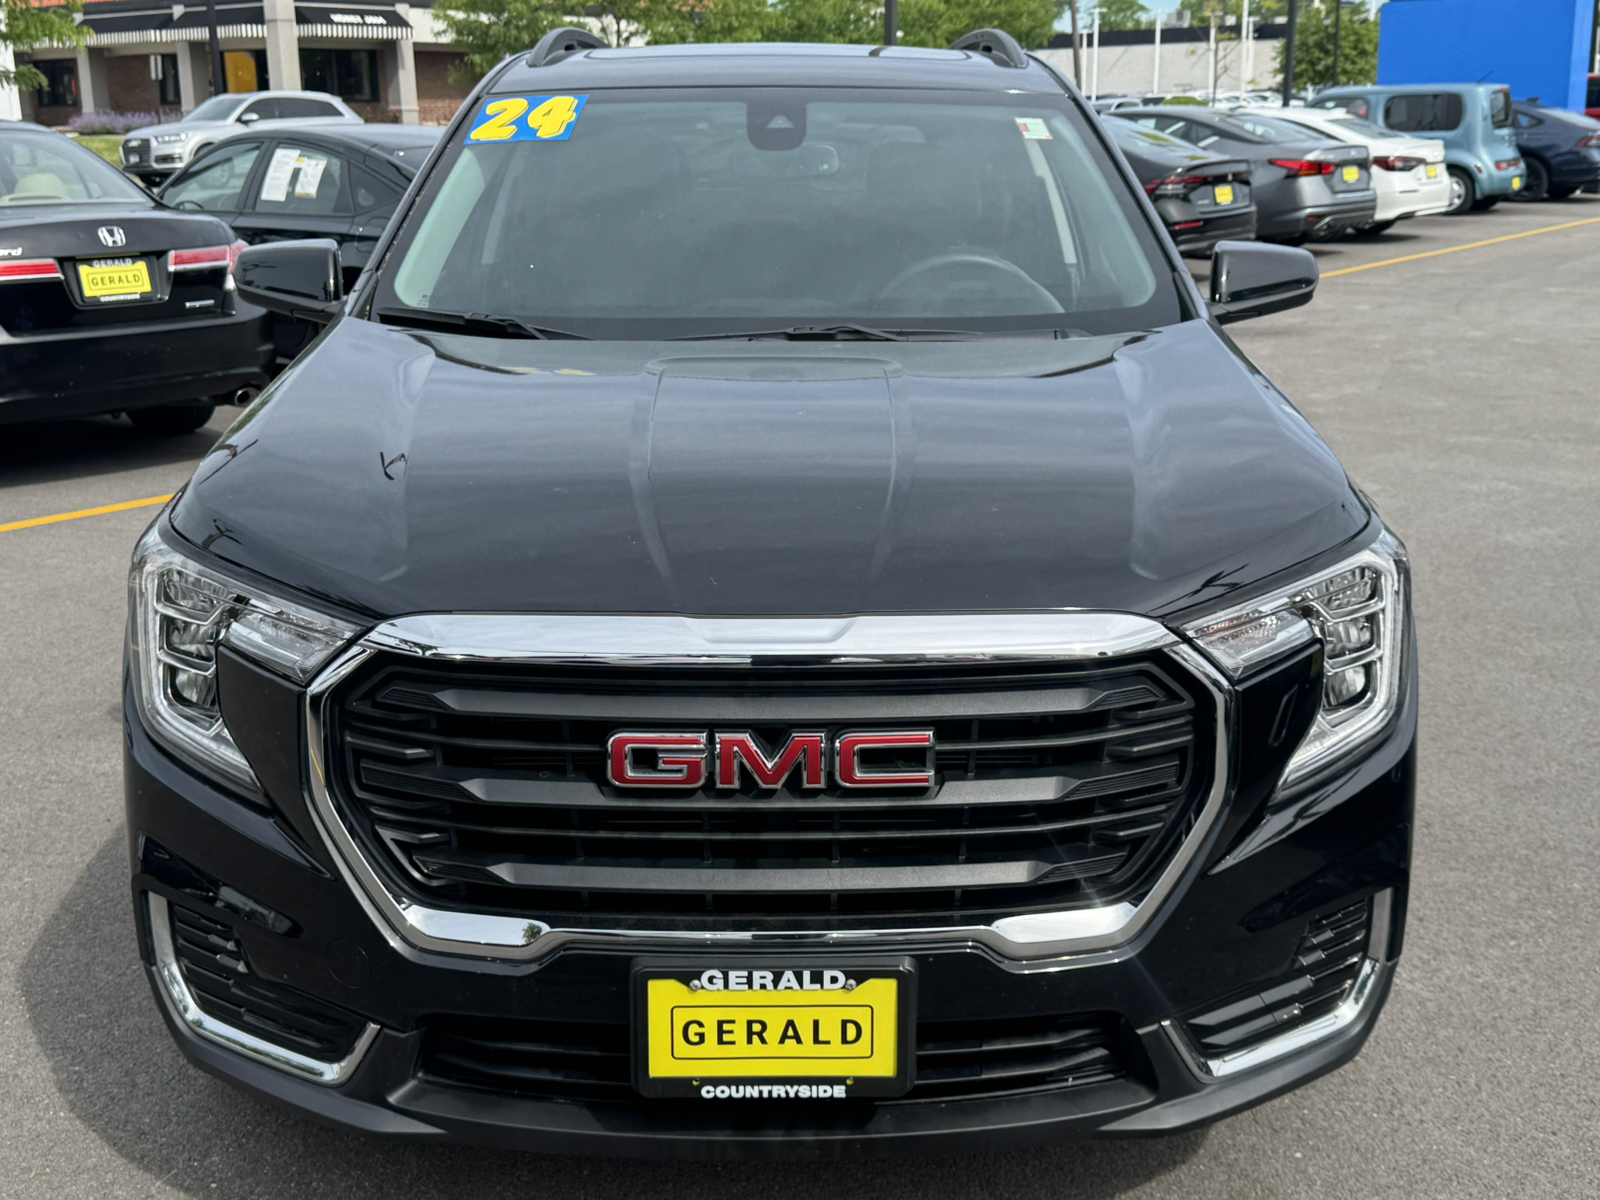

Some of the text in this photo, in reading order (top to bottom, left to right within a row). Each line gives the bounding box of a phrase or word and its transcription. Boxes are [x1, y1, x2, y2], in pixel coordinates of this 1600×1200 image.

[470, 96, 578, 141] 24
[93, 258, 133, 268] GERALD
[91, 274, 140, 287] GERALD
[606, 730, 936, 790] GMC
[700, 969, 847, 991] GERALD
[681, 1019, 863, 1046] GERALD
[700, 1085, 847, 1099] COUNTRYSIDE
